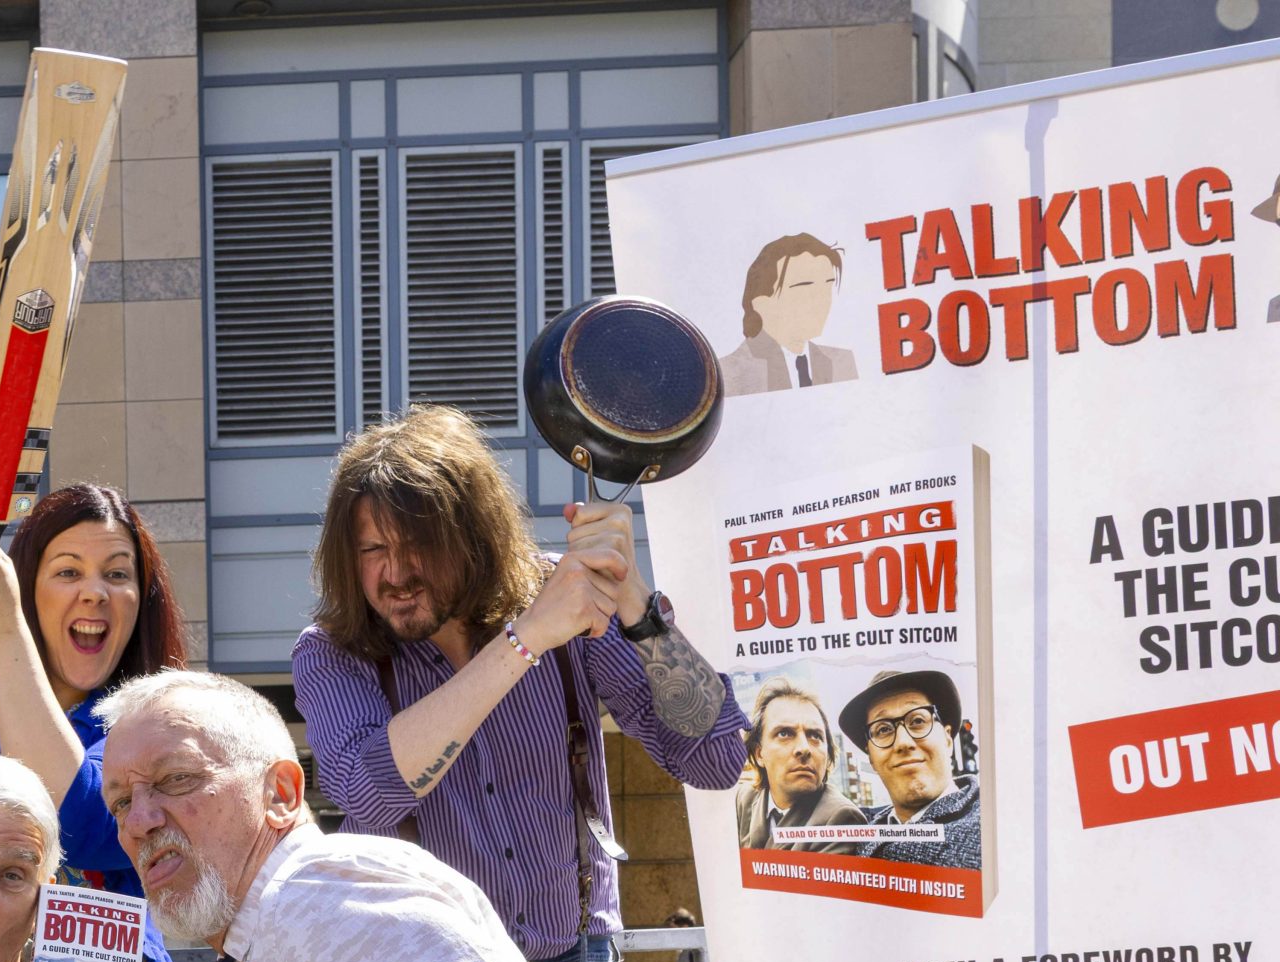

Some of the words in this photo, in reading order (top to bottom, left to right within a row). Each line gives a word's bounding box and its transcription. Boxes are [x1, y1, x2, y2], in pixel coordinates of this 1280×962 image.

[865, 166, 1235, 291] TALKING
[877, 253, 1236, 375] BOTTOM
[725, 516, 747, 528] PAUL
[749, 509, 784, 523] TANTER
[792, 500, 829, 516] ANGELA
[832, 489, 879, 508] PEARSON
[890, 482, 912, 496] MAT
[915, 476, 956, 491] BROOKS
[741, 506, 941, 556] TALKING
[1090, 515, 1124, 564] A
[730, 539, 957, 632] BOTTOM
[1114, 562, 1211, 618] THE
[736, 642, 745, 656] A
[749, 639, 793, 656] GUIDE
[797, 636, 817, 651] TO
[822, 634, 851, 650] THE
[856, 630, 893, 647] CULT
[899, 626, 957, 644] SITCOM
[1139, 614, 1280, 674] SITCO
[1109, 732, 1210, 794] OUT
[786, 830, 805, 838] LOAD
[820, 830, 834, 838] OLD
[879, 828, 907, 837] Richard
[909, 828, 938, 837] Richard
[752, 861, 809, 879] WARNING:
[814, 866, 886, 889] GUARANTEED
[889, 875, 916, 893] FILTH
[921, 880, 965, 899] INSIDE
[44, 913, 140, 954] BOTTOM
[53, 902, 135, 921] TALKING
